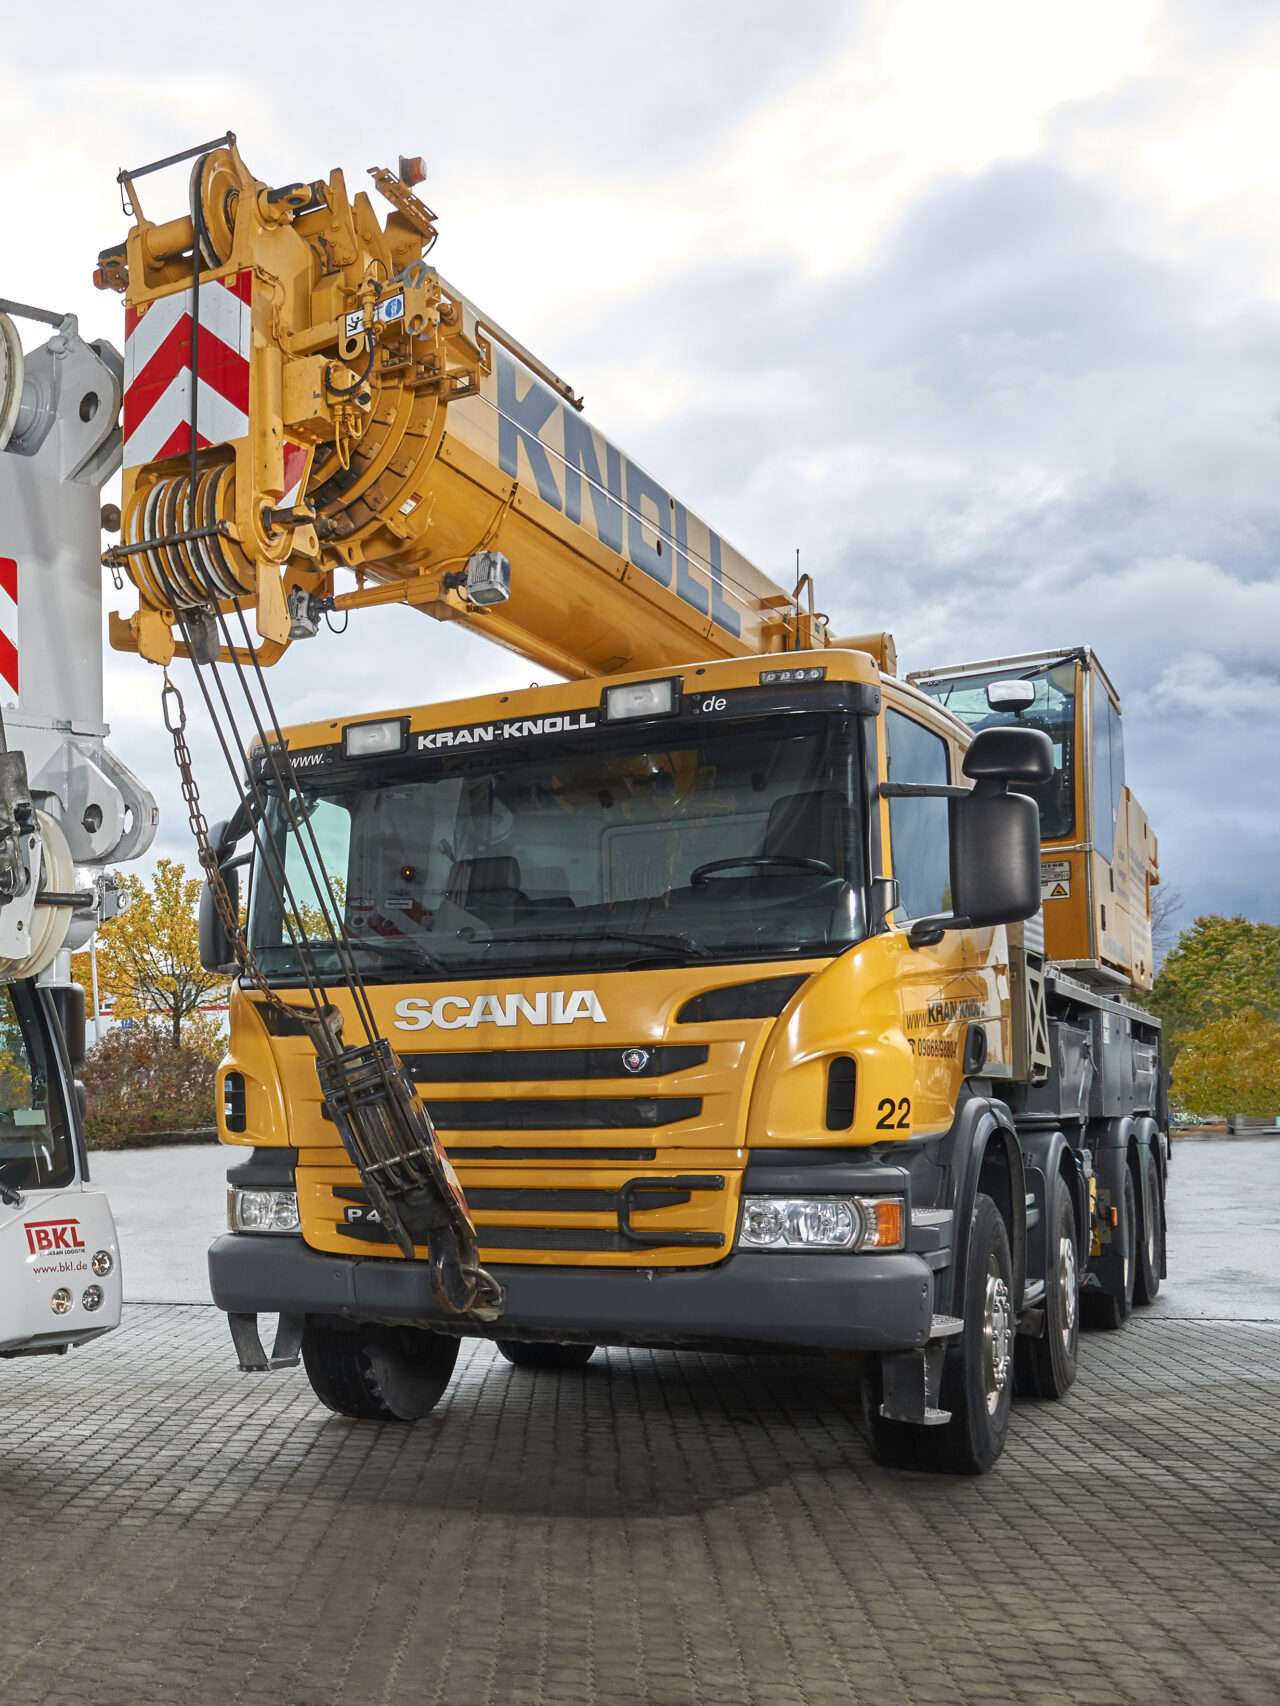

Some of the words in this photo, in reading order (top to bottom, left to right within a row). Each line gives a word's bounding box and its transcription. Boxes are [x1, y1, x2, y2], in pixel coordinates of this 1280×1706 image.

[496, 345, 742, 640] KNOLL
[417, 712, 596, 751] KRAN-KNOLL
[702, 695, 727, 713] de
[393, 989, 609, 1032] SCANIA
[875, 1097, 911, 1130] 22
[347, 1208, 363, 1224] P
[34, 1226, 86, 1250] BKL
[32, 1261, 88, 1274] www.bkl.de
